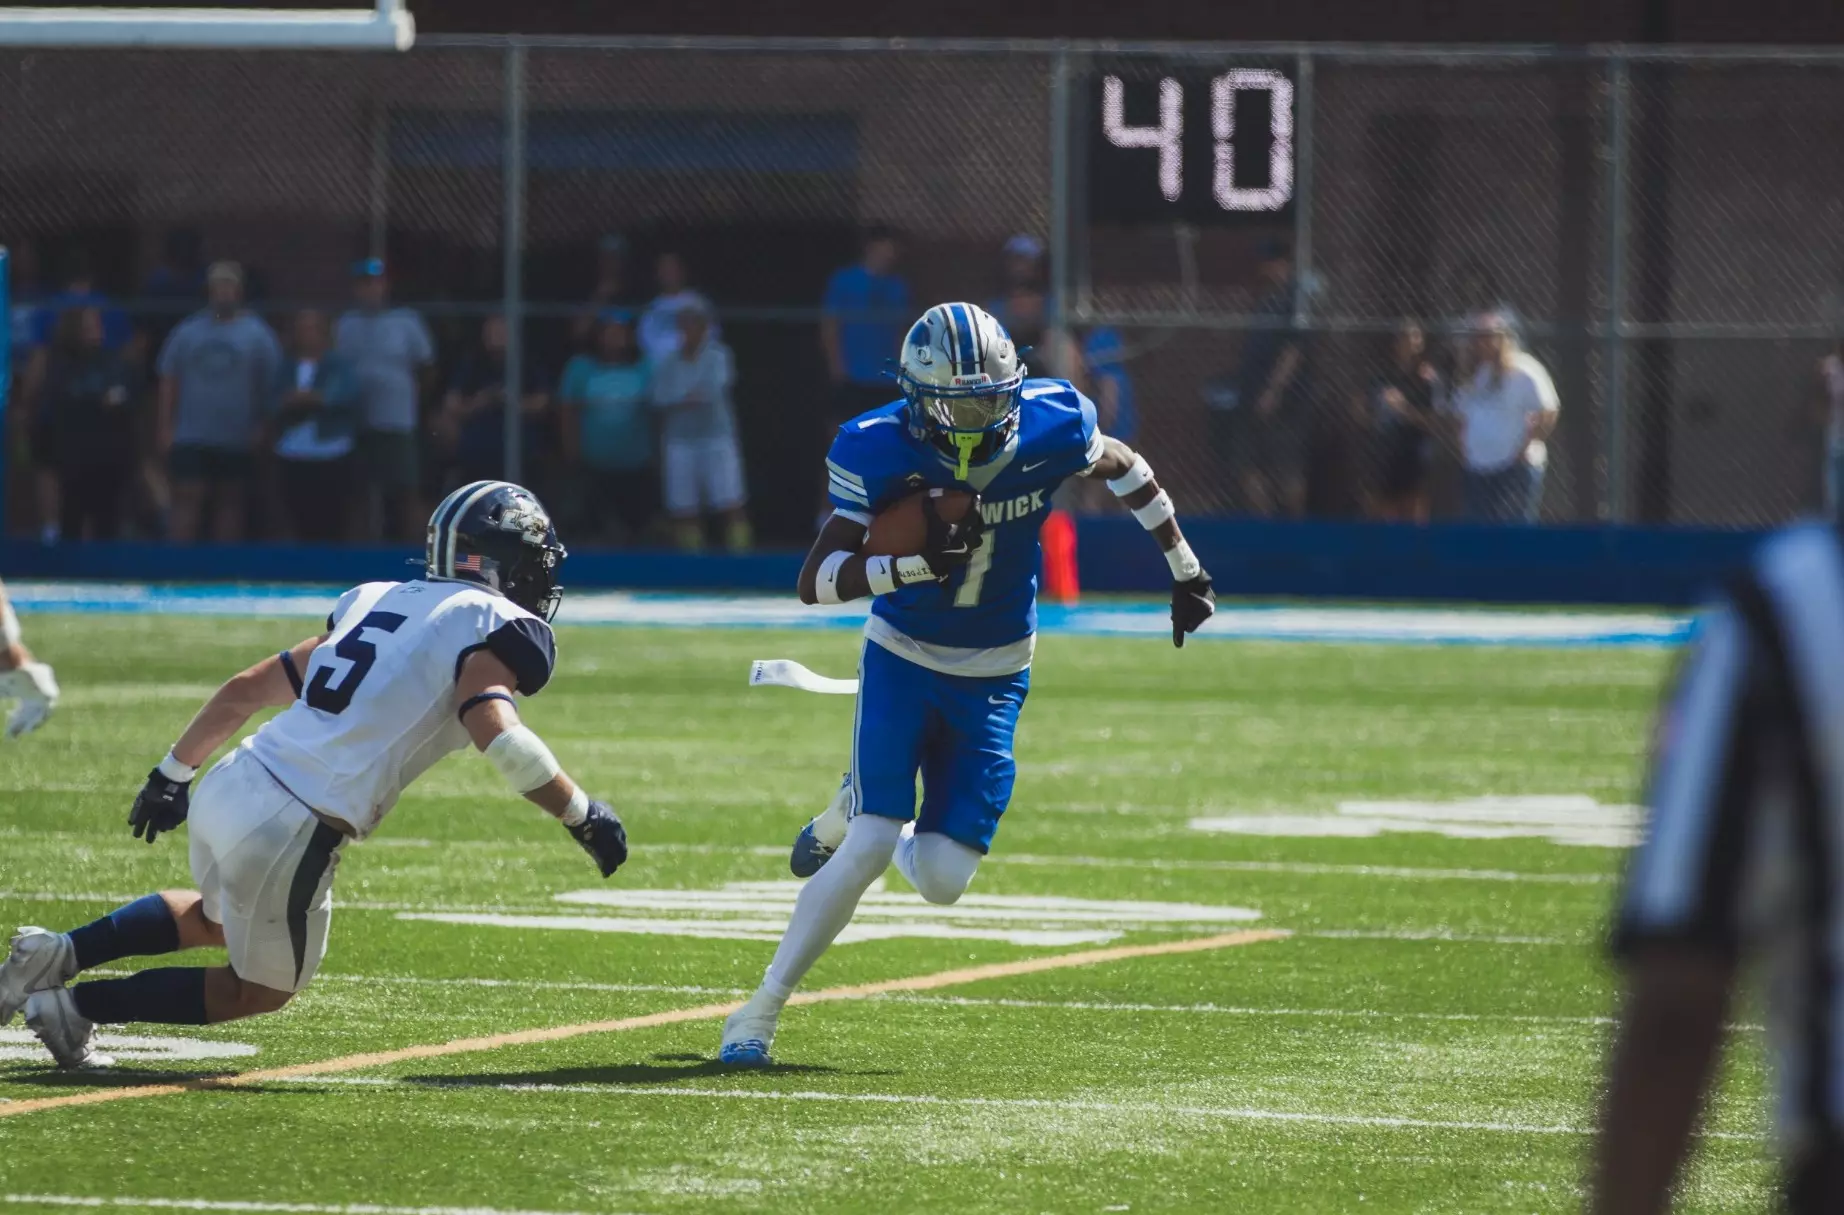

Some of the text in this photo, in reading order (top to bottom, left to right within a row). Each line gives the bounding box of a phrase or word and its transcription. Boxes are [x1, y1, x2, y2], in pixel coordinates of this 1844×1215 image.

[1103, 67, 1294, 211] 40
[980, 488, 1046, 525] WICK
[306, 611, 408, 715] 5
